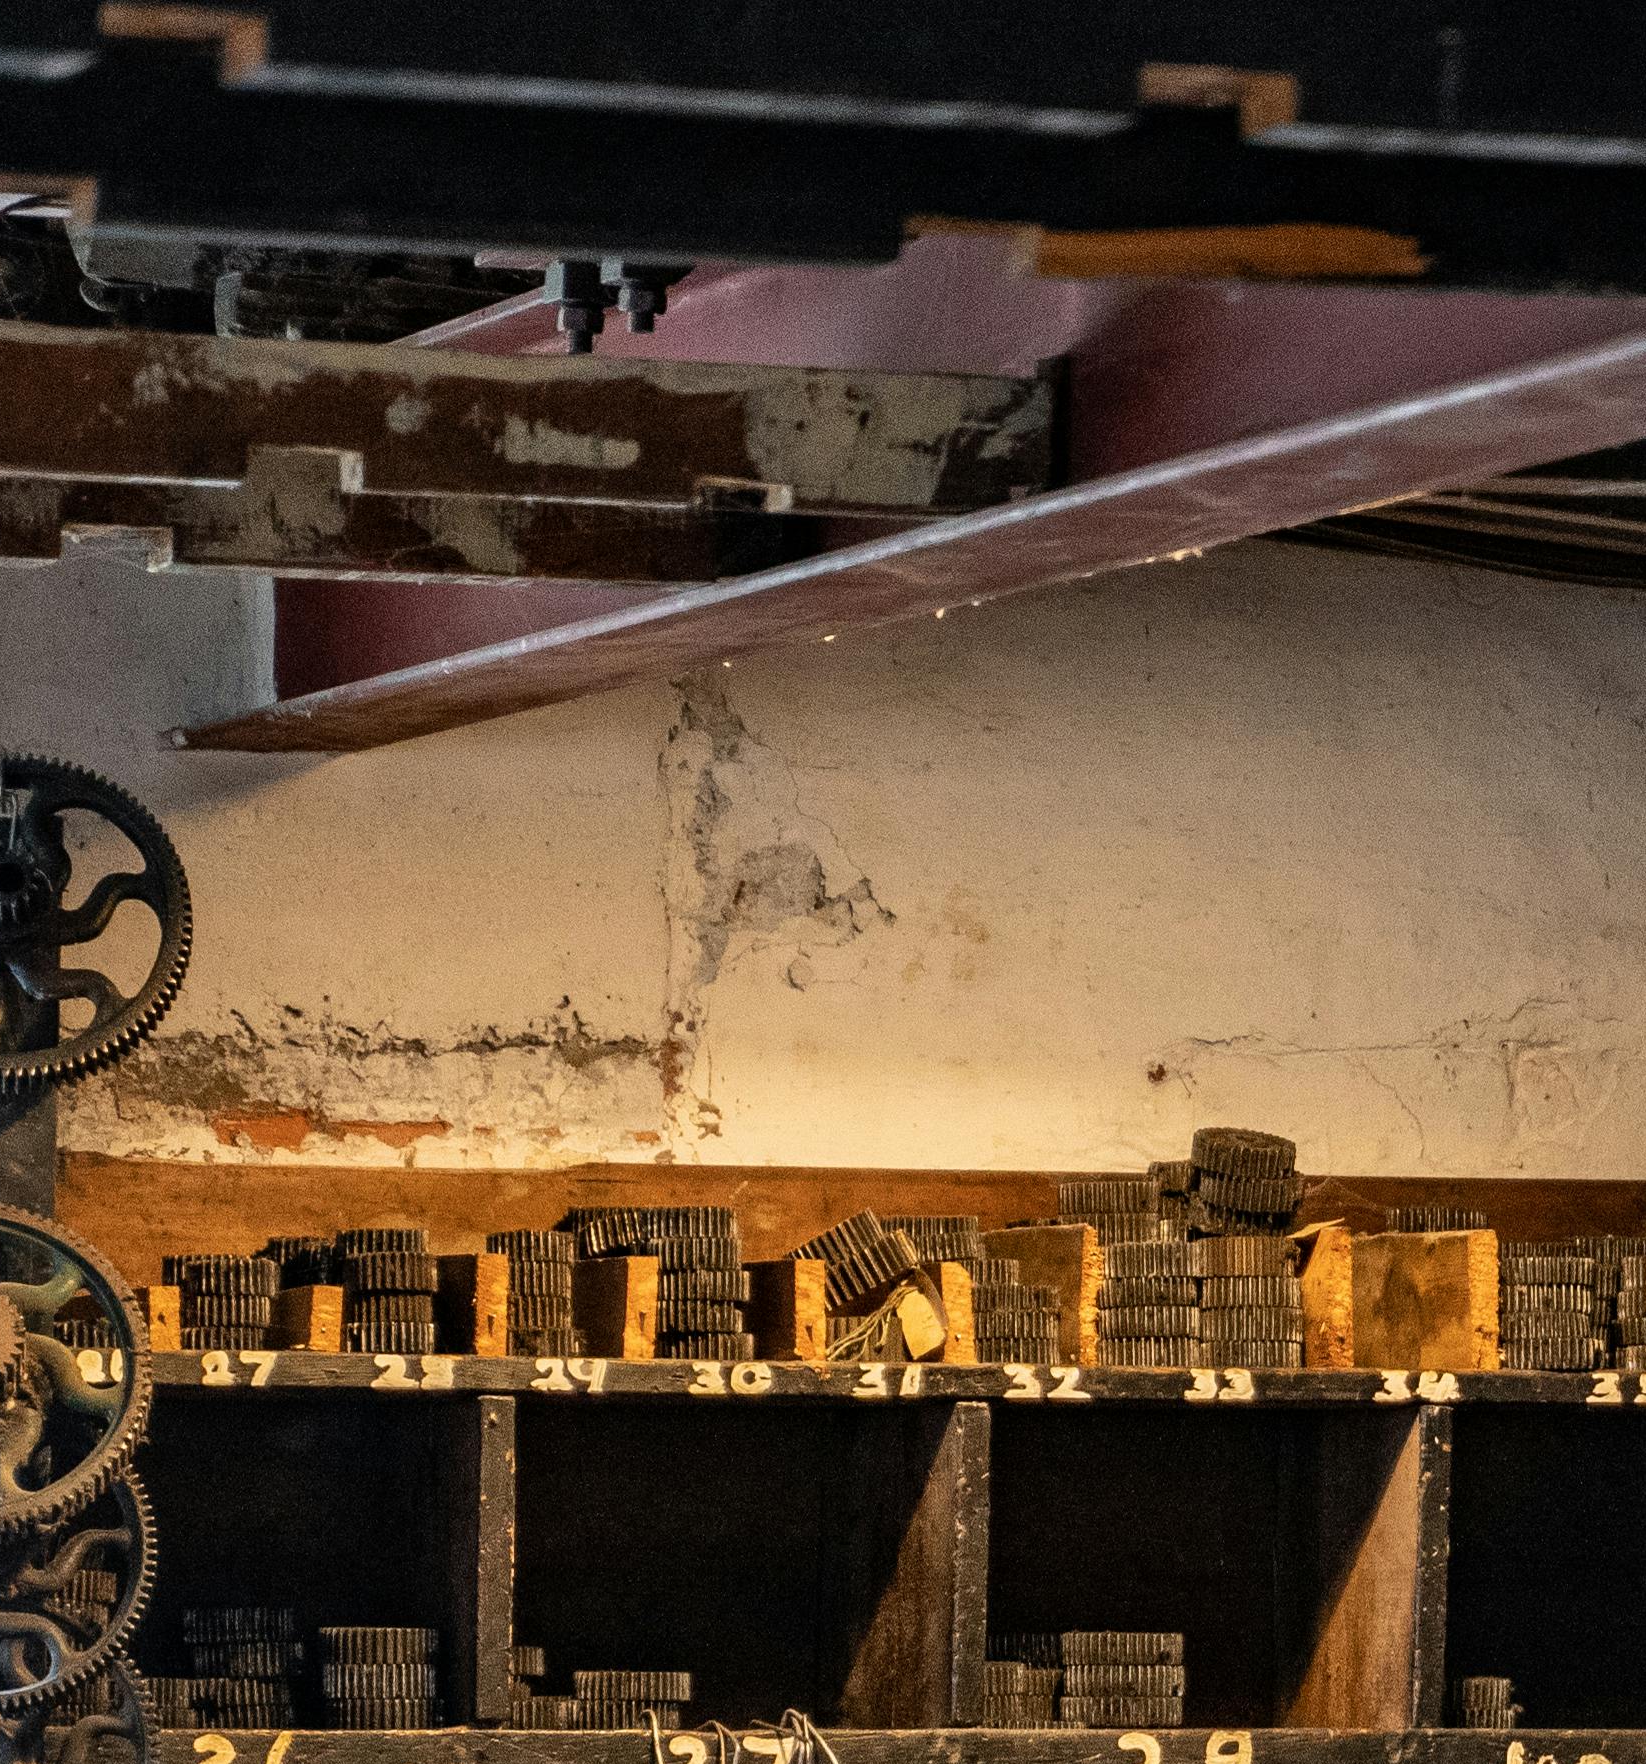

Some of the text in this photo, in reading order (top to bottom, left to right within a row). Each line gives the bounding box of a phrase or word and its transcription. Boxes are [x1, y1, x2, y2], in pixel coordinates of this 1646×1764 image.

[202, 1350, 279, 1387] 27
[531, 1357, 606, 1393] 29
[688, 1361, 774, 1395] 30
[853, 1362, 923, 1397] 31
[1004, 1364, 1090, 1399] 32
[1185, 1367, 1255, 1401] 33
[1374, 1369, 1460, 1403] 34
